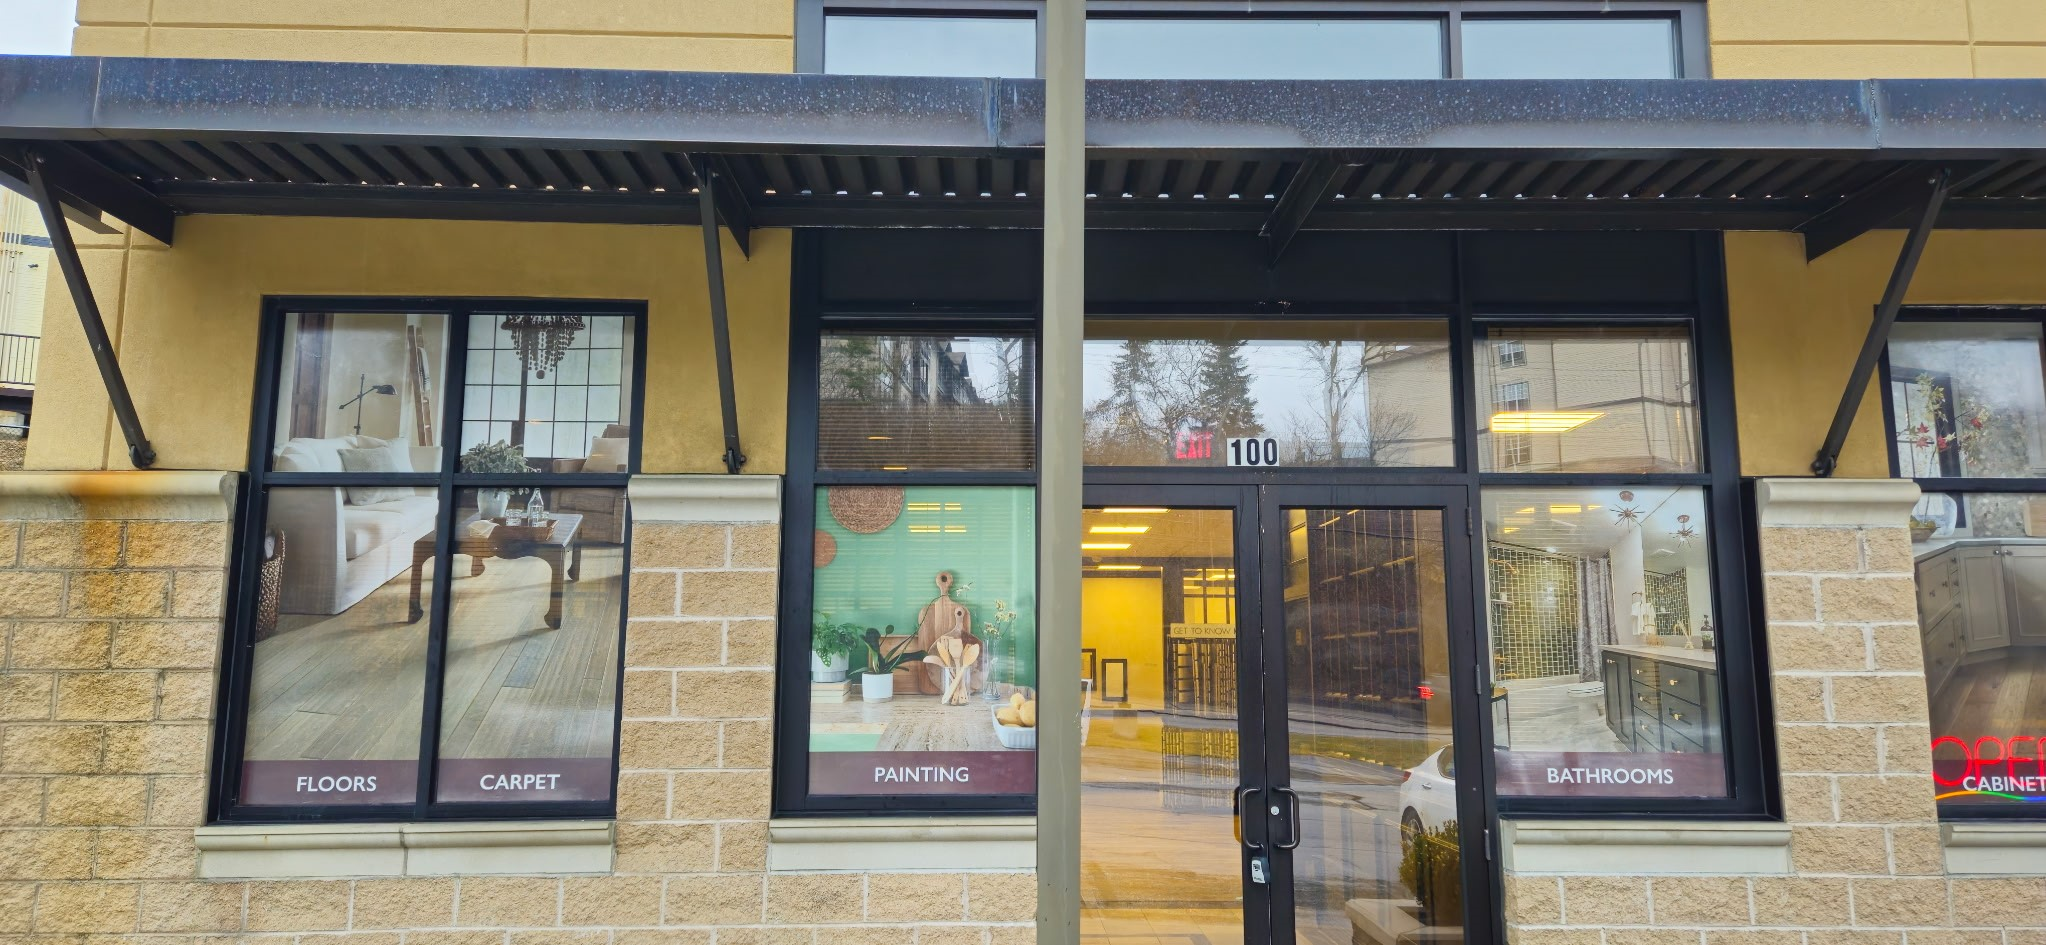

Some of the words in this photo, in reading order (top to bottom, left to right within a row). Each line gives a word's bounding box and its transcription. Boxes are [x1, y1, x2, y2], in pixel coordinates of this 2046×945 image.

[1175, 431, 1214, 459] EXIT
[1231, 438, 1278, 466] 100
[1173, 627, 1188, 635] GET
[1191, 627, 1203, 635] TO
[1204, 627, 1231, 635] KNOW
[296, 775, 377, 792] FLOORS
[480, 773, 561, 791] CARPET
[874, 767, 969, 783] PAINTING
[1547, 768, 1674, 785] BATHROOMS
